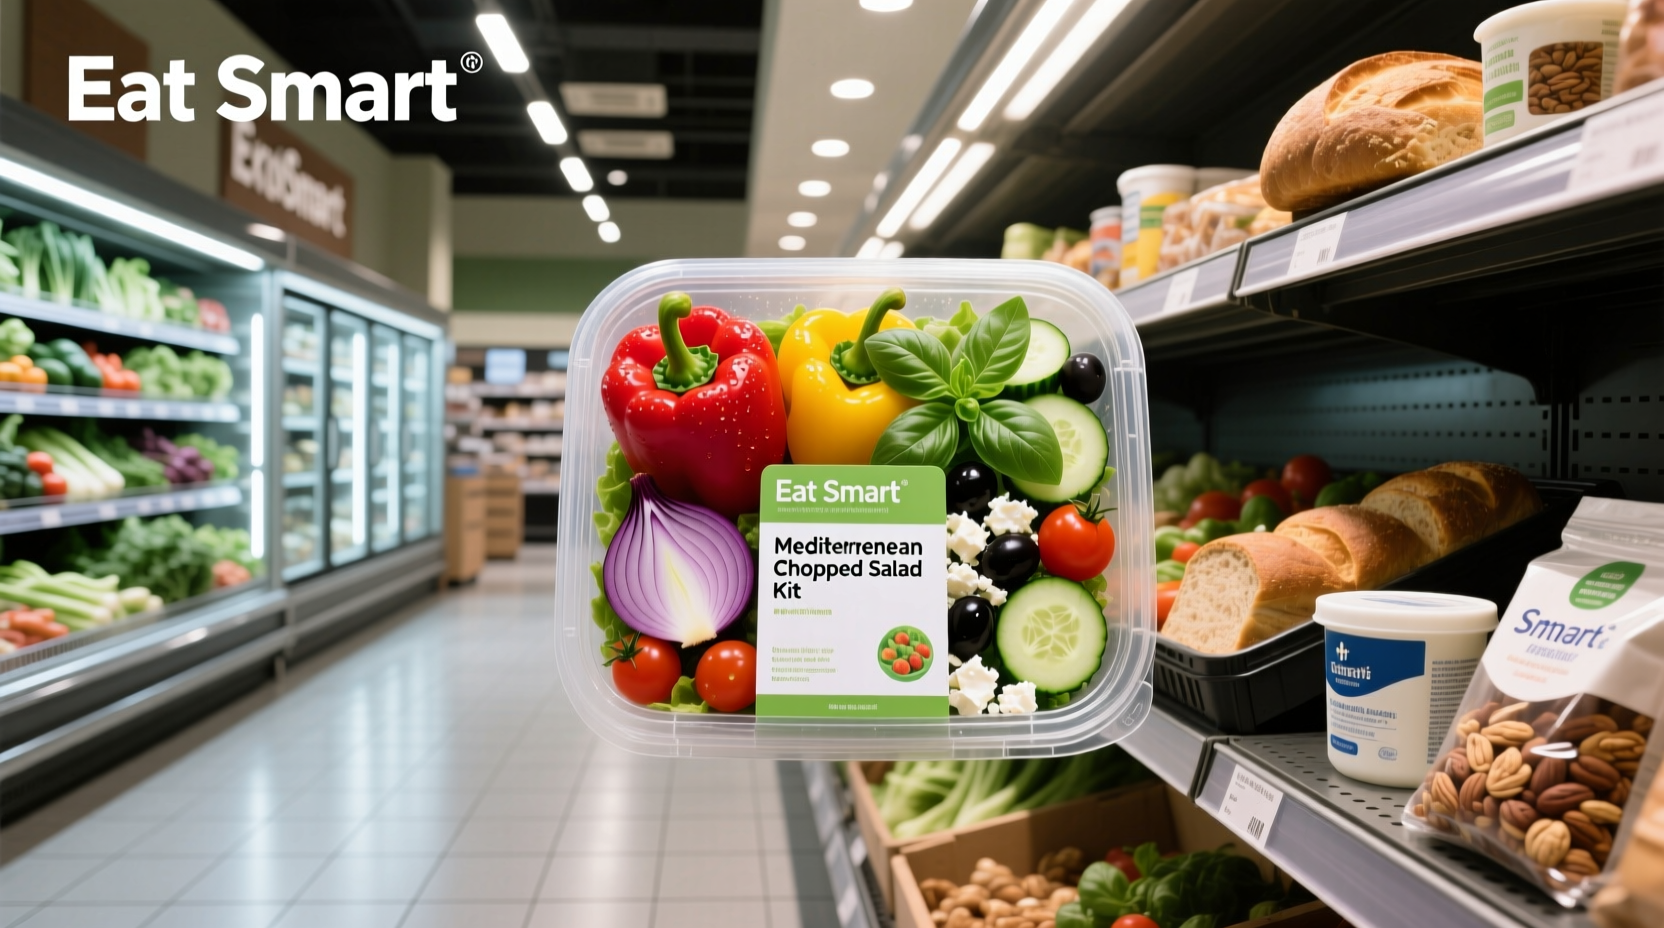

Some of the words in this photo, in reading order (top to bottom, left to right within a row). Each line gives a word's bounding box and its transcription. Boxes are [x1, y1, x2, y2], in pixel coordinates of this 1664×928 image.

[776, 479, 817, 503] Eat
[823, 479, 901, 504] Smart
[773, 559, 863, 582] Chopped
[868, 559, 922, 577] Salad
[773, 581, 802, 600] Kit
